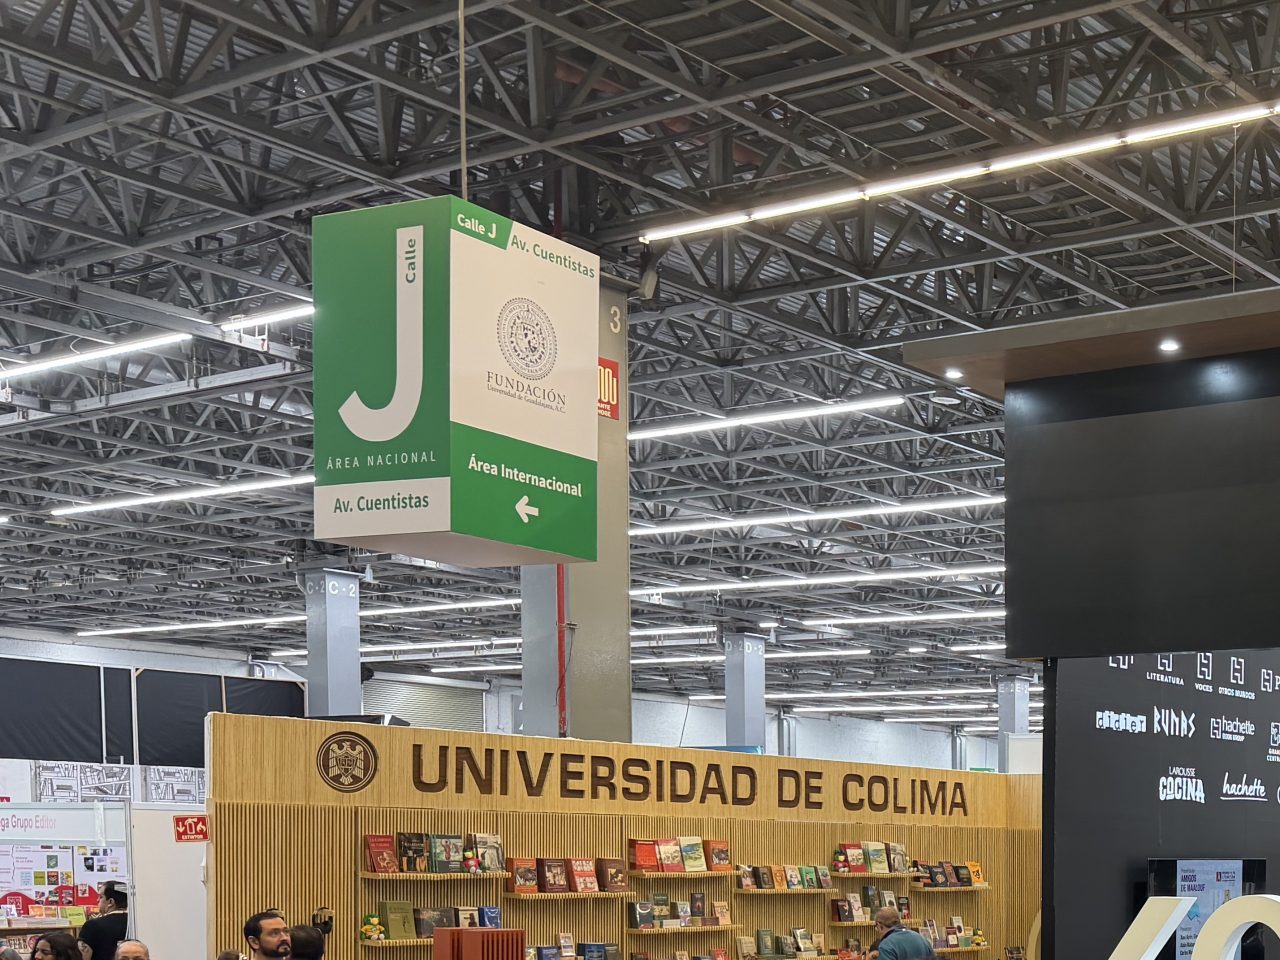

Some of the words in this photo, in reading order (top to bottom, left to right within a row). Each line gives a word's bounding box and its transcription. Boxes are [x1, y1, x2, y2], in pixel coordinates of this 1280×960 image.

[457, 213, 485, 236] Calle
[487, 223, 497, 239] J
[405, 238, 417, 284] Calle
[511, 234, 530, 255] Av.
[533, 243, 596, 279] Cuentistas
[338, 225, 423, 442] J
[487, 371, 566, 405] FUNDACIÓN
[487, 383, 516, 398] Universidad
[327, 455, 359, 470] ÁREA
[367, 450, 437, 467] NACIONAL
[469, 453, 498, 476] Área
[501, 464, 582, 498] Internacional
[333, 497, 353, 514] Av.
[357, 492, 429, 511] Cuentistas
[1146, 672, 1184, 686] LITERATURA
[1195, 683, 1213, 693] VOCES
[1154, 705, 1196, 738] RUNAS
[1222, 715, 1256, 736] hachette
[412, 743, 758, 806] UNIVERSIDAD
[777, 768, 824, 809] DE
[842, 773, 969, 817] COLIMA
[1169, 766, 1196, 777] LAROUSSE
[1159, 776, 1206, 804] COCINA
[1222, 772, 1266, 797] hachette
[11, 814, 33, 832] Grupo
